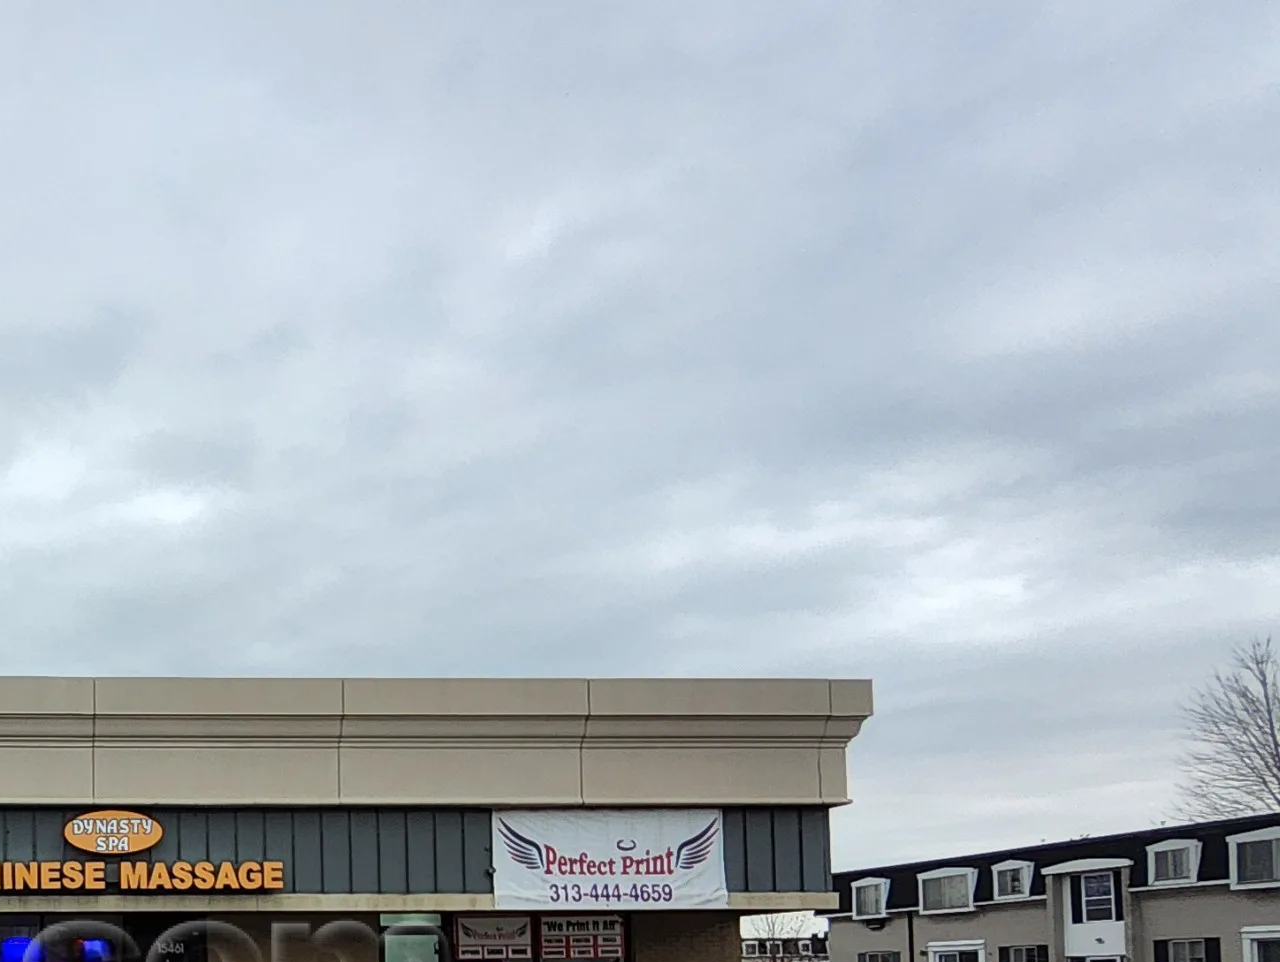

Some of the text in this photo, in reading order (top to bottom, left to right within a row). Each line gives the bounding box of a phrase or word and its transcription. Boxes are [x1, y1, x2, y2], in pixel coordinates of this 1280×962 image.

[72, 819, 153, 835] DYNASTY
[95, 836, 130, 852] SPA
[543, 844, 674, 876] Perfect Print
[119, 861, 285, 890] MASSAGE
[549, 883, 673, 903] 313-444-4659
